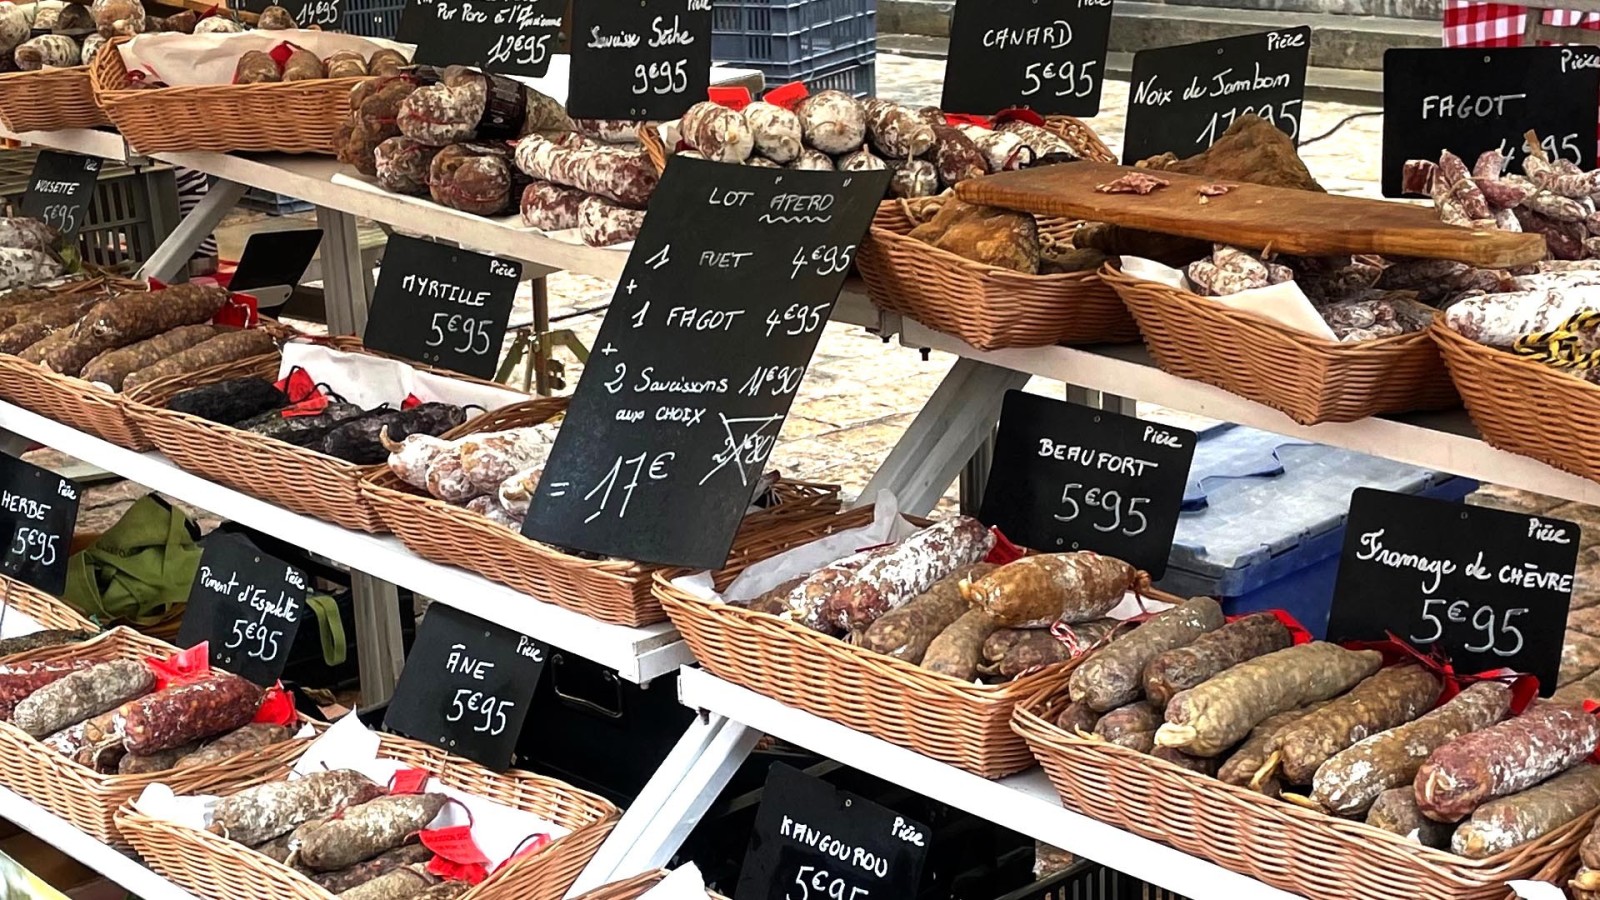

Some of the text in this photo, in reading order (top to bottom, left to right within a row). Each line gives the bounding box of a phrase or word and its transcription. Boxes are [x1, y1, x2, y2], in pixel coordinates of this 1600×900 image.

[437, 3, 457, 20] Pur
[462, 3, 487, 23] Porc
[983, 20, 1072, 49] CANARD
[1266, 32, 1305, 51] Pièce
[632, 58, 688, 94] 9€95
[1021, 61, 1097, 97] 5€95
[1133, 62, 1290, 106] Noix de Jambon
[1422, 93, 1527, 120] FAGOT
[34, 180, 80, 195] NOISETTE
[709, 187, 754, 206] LOT
[43, 204, 80, 233] 5€95
[490, 260, 517, 278] Pièce
[645, 244, 856, 280] 1 FUET 4€95
[402, 274, 491, 306] MYRTILLE
[426, 313, 493, 355] 5€95
[631, 301, 831, 337] 1 FAGOT 4€95
[604, 363, 627, 394] 2
[739, 366, 804, 397] 11€90
[655, 406, 706, 425] CHOIX
[1143, 425, 1183, 449] Pièce
[1038, 438, 1158, 477] BEAUFORT
[1, 490, 52, 520] HERBE
[584, 452, 675, 523] 17€
[1054, 483, 1150, 536] 5€95
[12, 527, 60, 565] 5€95
[1528, 518, 1570, 544] Pièce
[1356, 529, 1573, 594] Fromage de CHÈVRE
[200, 566, 239, 595] Piment
[224, 619, 283, 661] 5€95
[1410, 599, 1529, 656] 5€95
[446, 643, 494, 680] ÂNE
[446, 689, 515, 736] 5€95
[780, 815, 888, 878] KANGOUROU
